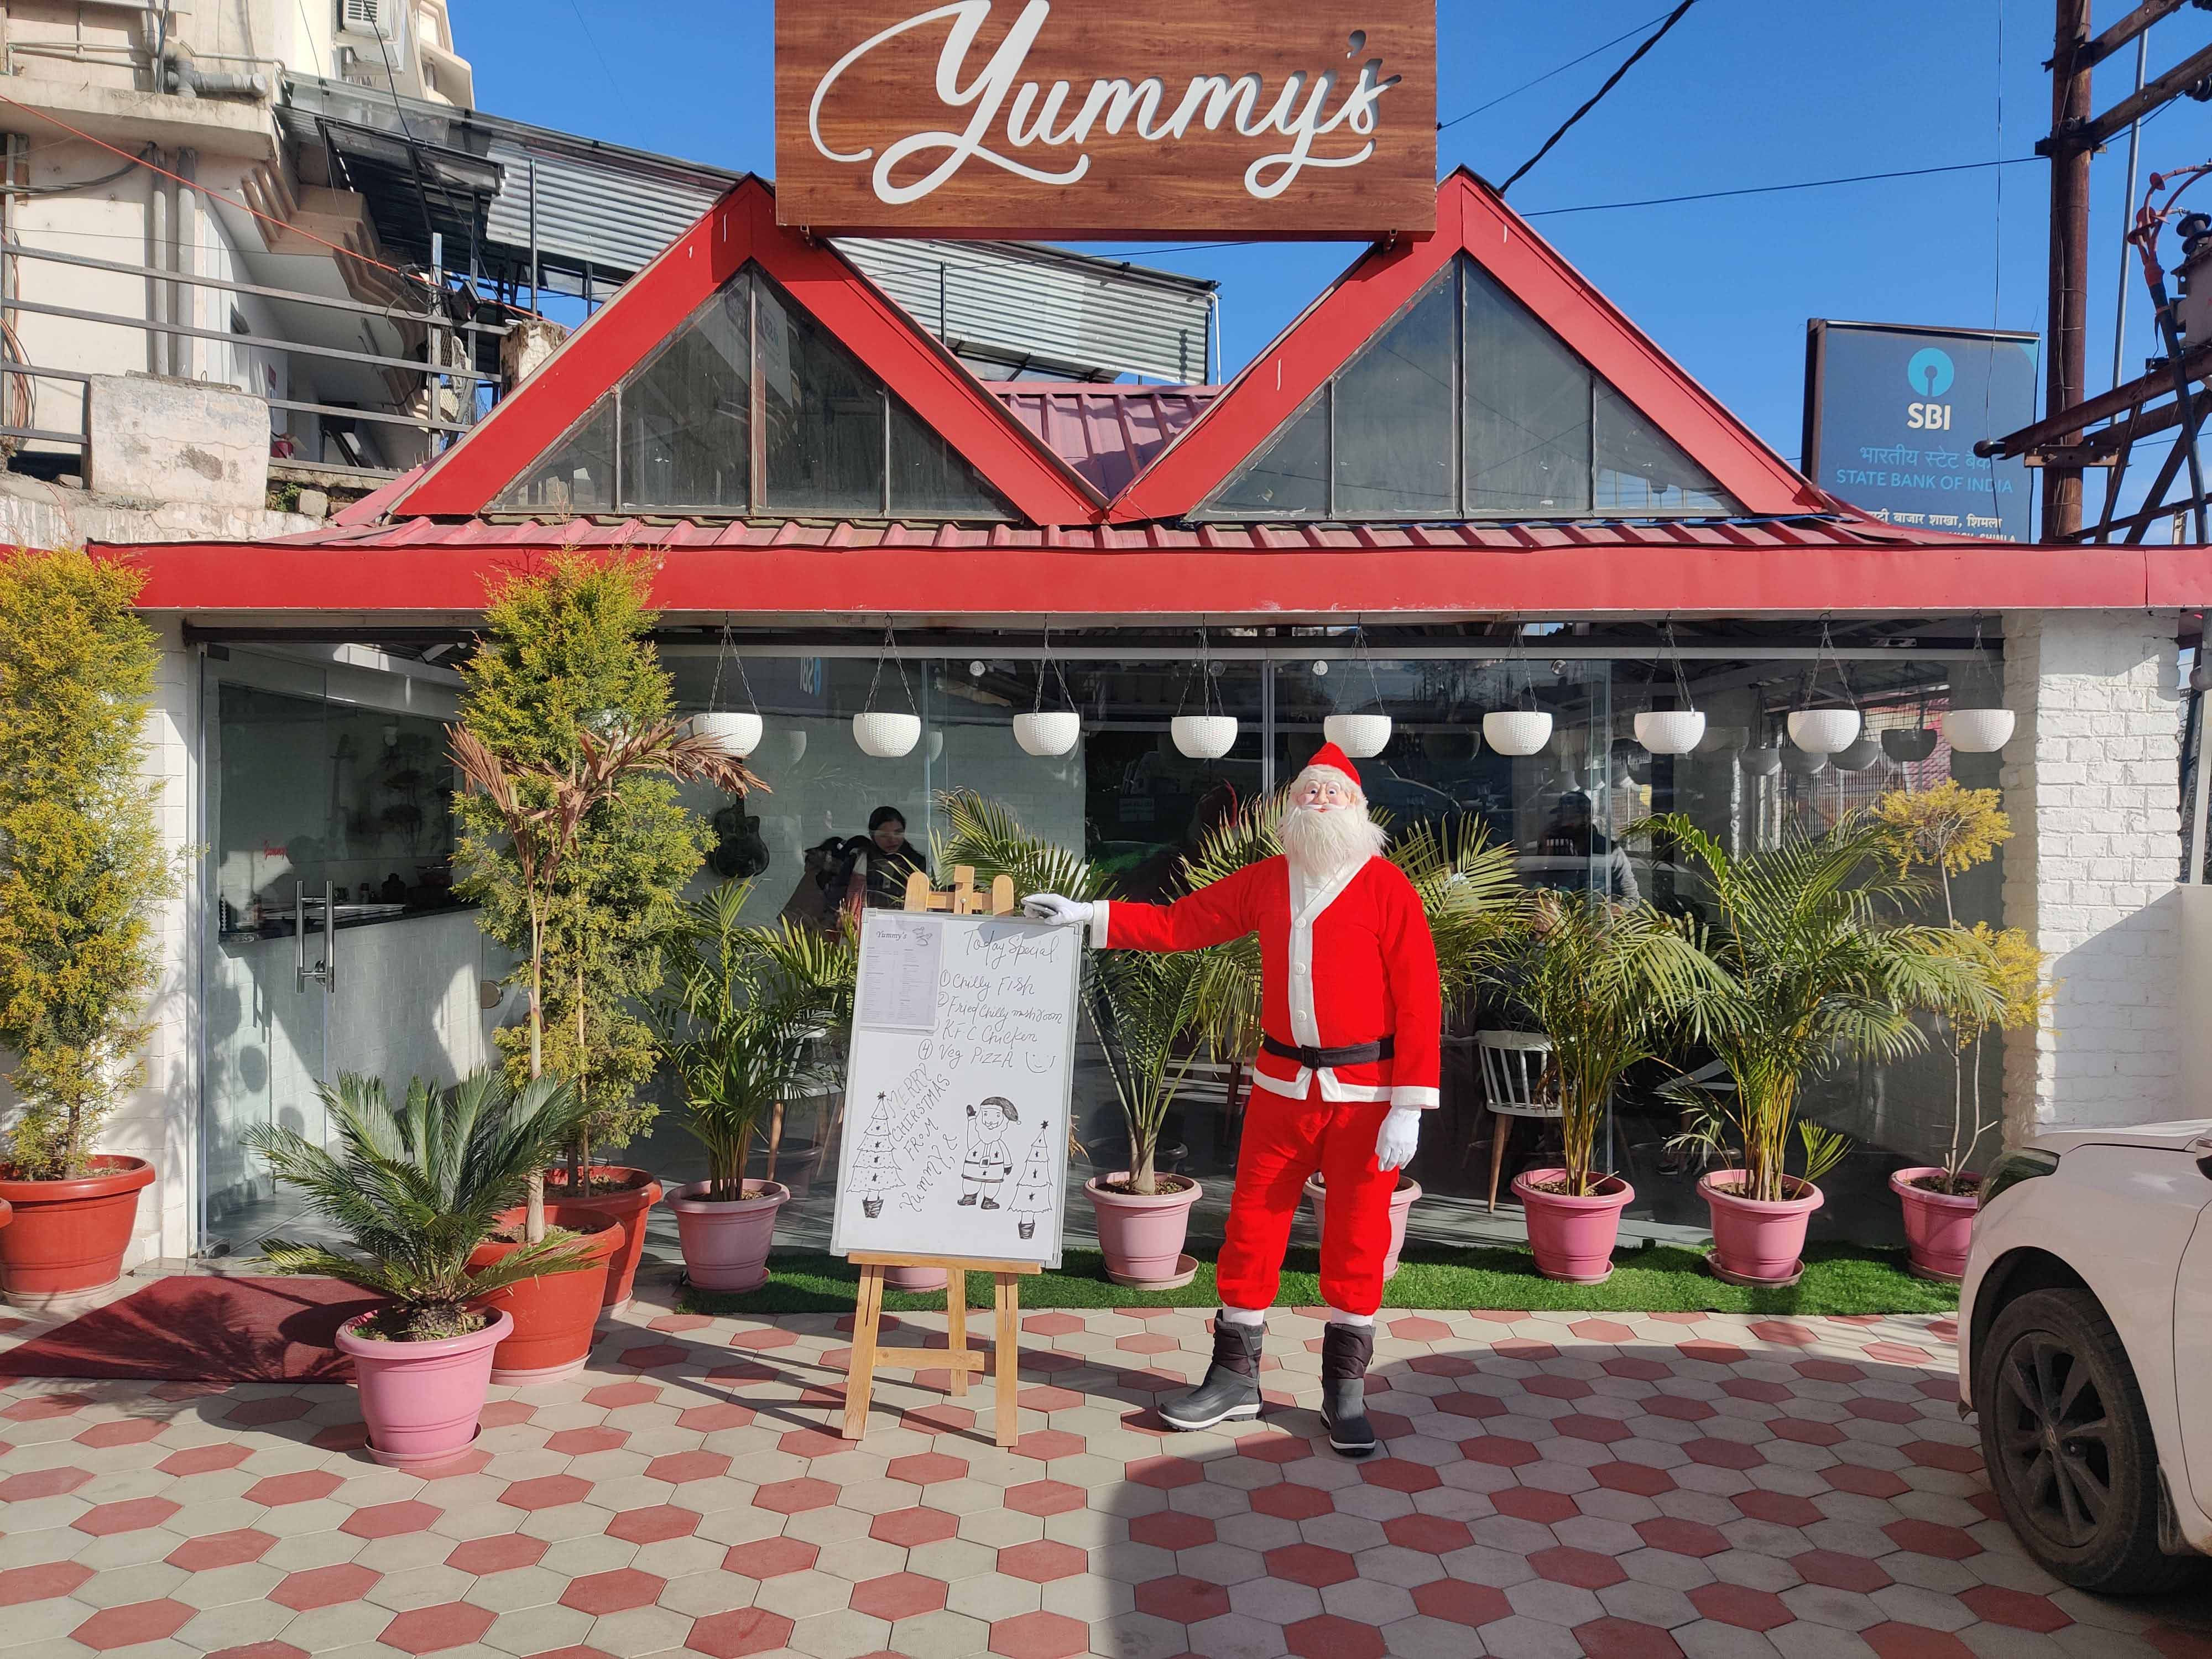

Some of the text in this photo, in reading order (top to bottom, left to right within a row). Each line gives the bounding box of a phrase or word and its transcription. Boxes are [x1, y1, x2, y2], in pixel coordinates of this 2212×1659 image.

[809, 0, 1401, 205] Yummy's
[1907, 403, 1951, 430] SBI
[1860, 444, 1920, 466] भारतीय
[1924, 445, 1960, 468] स्टेट
[1837, 469, 2013, 493] STATE BANK OF INDIA
[1893, 512, 1924, 524] बाजार
[1966, 513, 2002, 529] शिमला
[876, 930, 907, 941] Yummy's
[964, 930, 1059, 969] Today Special
[953, 973, 991, 1001] Chilly
[947, 996, 980, 1024] Fried
[982, 1025, 1037, 1050] Chicken
[939, 1044, 963, 1069] Veg
[886, 1062, 932, 1118] MERRY
